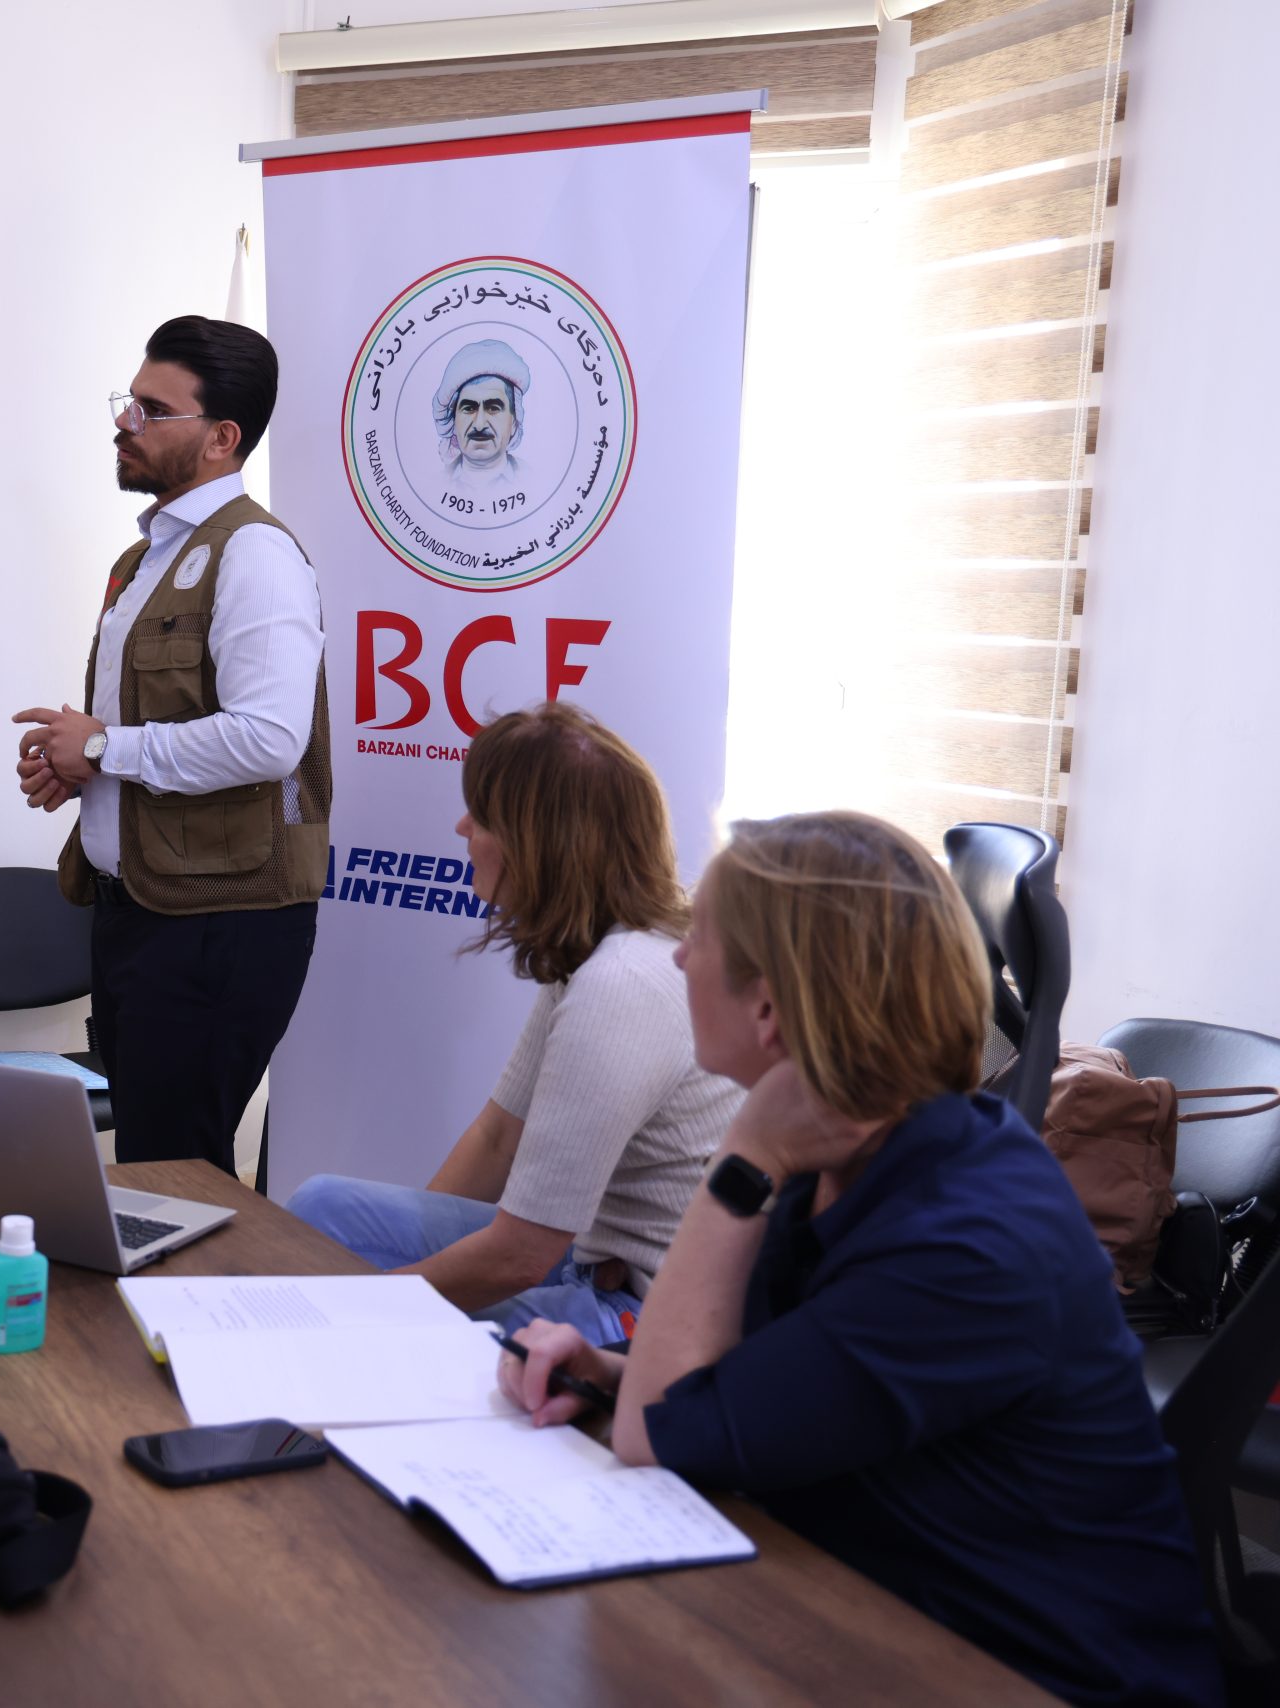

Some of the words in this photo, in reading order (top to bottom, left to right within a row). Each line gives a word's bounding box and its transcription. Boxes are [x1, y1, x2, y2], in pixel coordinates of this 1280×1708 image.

[577, 425, 609, 500] مؤسسة
[365, 429, 388, 488] BARZANI
[380, 485, 414, 531] CHARITY
[410, 526, 480, 569] FOUNDATION
[440, 491, 474, 514] 1903
[492, 491, 526, 514] 1979
[545, 502, 583, 549] بارزاني
[482, 538, 539, 569] الخيرية
[356, 610, 611, 738] BCF
[356, 739, 420, 758] BARZANI
[346, 847, 475, 886] FRIED
